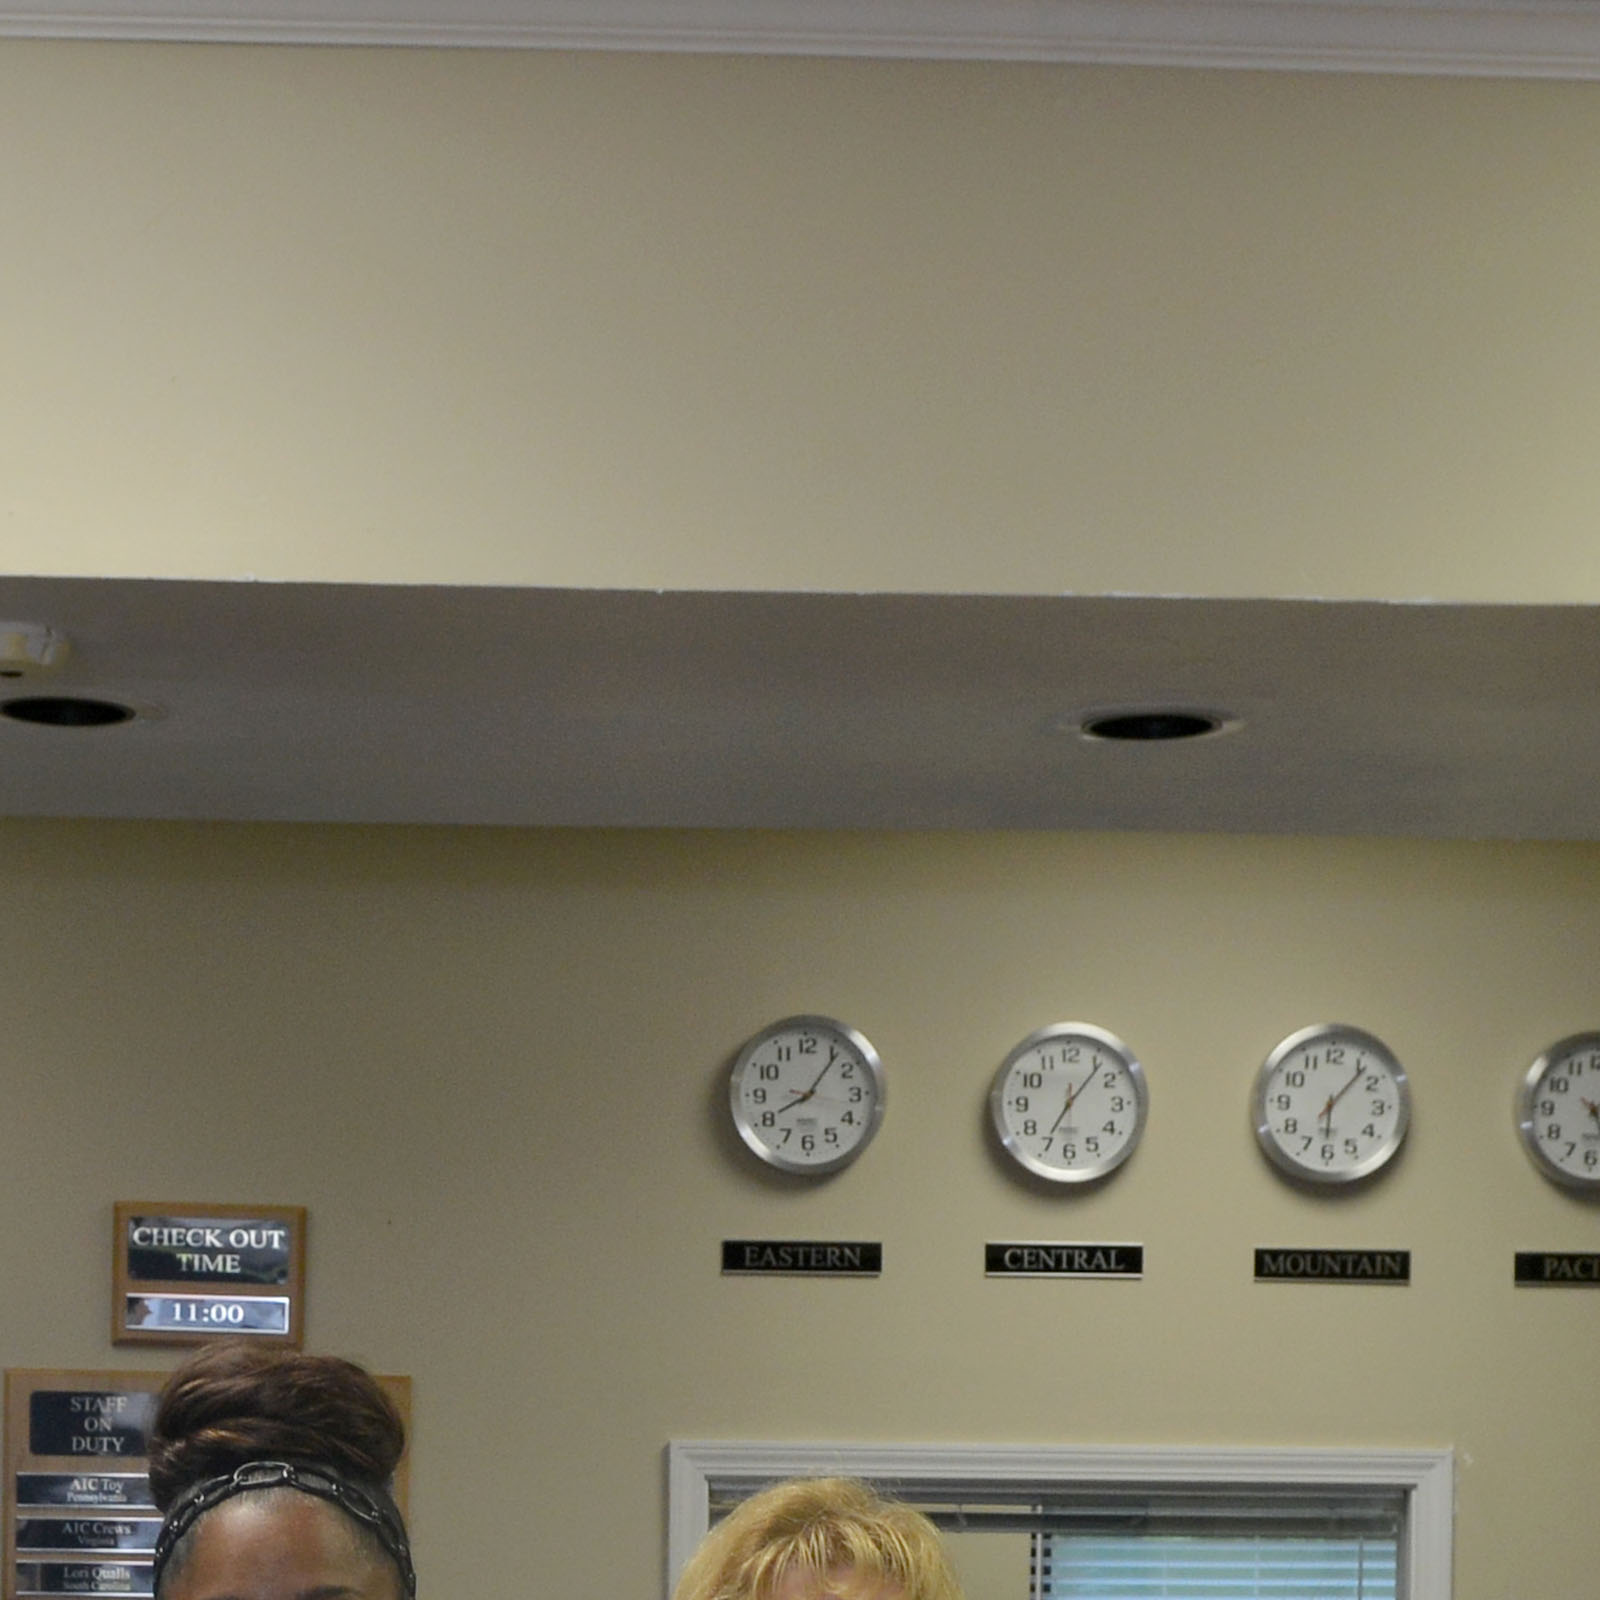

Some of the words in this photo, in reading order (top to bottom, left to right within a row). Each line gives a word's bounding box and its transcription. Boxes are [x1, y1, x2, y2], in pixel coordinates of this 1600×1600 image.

[777, 1046, 791, 1062] 11
[798, 1038, 817, 1054] 12
[1041, 1055, 1055, 1071] 11
[1061, 1047, 1080, 1063] 12
[759, 1064, 779, 1081] 10
[841, 1063, 854, 1079] 2
[1022, 1073, 1042, 1089] 10
[1104, 1073, 1116, 1089] 2
[752, 1088, 766, 1104] 9
[849, 1087, 862, 1103] 3
[1015, 1096, 1029, 1112] 9
[1111, 1097, 1124, 1112] 3
[762, 1111, 775, 1127] 8
[840, 1110, 854, 1125] 4
[780, 1128, 792, 1144] 7
[824, 1128, 837, 1143] 5
[1023, 1120, 1037, 1136] 8
[1102, 1120, 1116, 1136] 4
[801, 1135, 815, 1151] 6
[1042, 1136, 1054, 1152] 7
[1085, 1136, 1099, 1153] 5
[1062, 1143, 1076, 1160] 6
[133, 1227, 222, 1248] CHECK
[228, 1228, 286, 1250] OUT
[176, 1253, 241, 1274] TIME
[744, 1247, 861, 1268] EASTERN
[1004, 1249, 1125, 1270] CENTRAL
[1262, 1254, 1401, 1276] MOUNTAIN
[172, 1303, 244, 1323] 11:00
[70, 1396, 128, 1413] STAFF
[84, 1416, 112, 1431] ON
[71, 1436, 125, 1451] DUTY
[102, 1479, 124, 1494] Toy
[92, 1522, 131, 1536] Crews
[64, 1566, 90, 1579] Lori
[92, 1566, 131, 1580] Qualls
